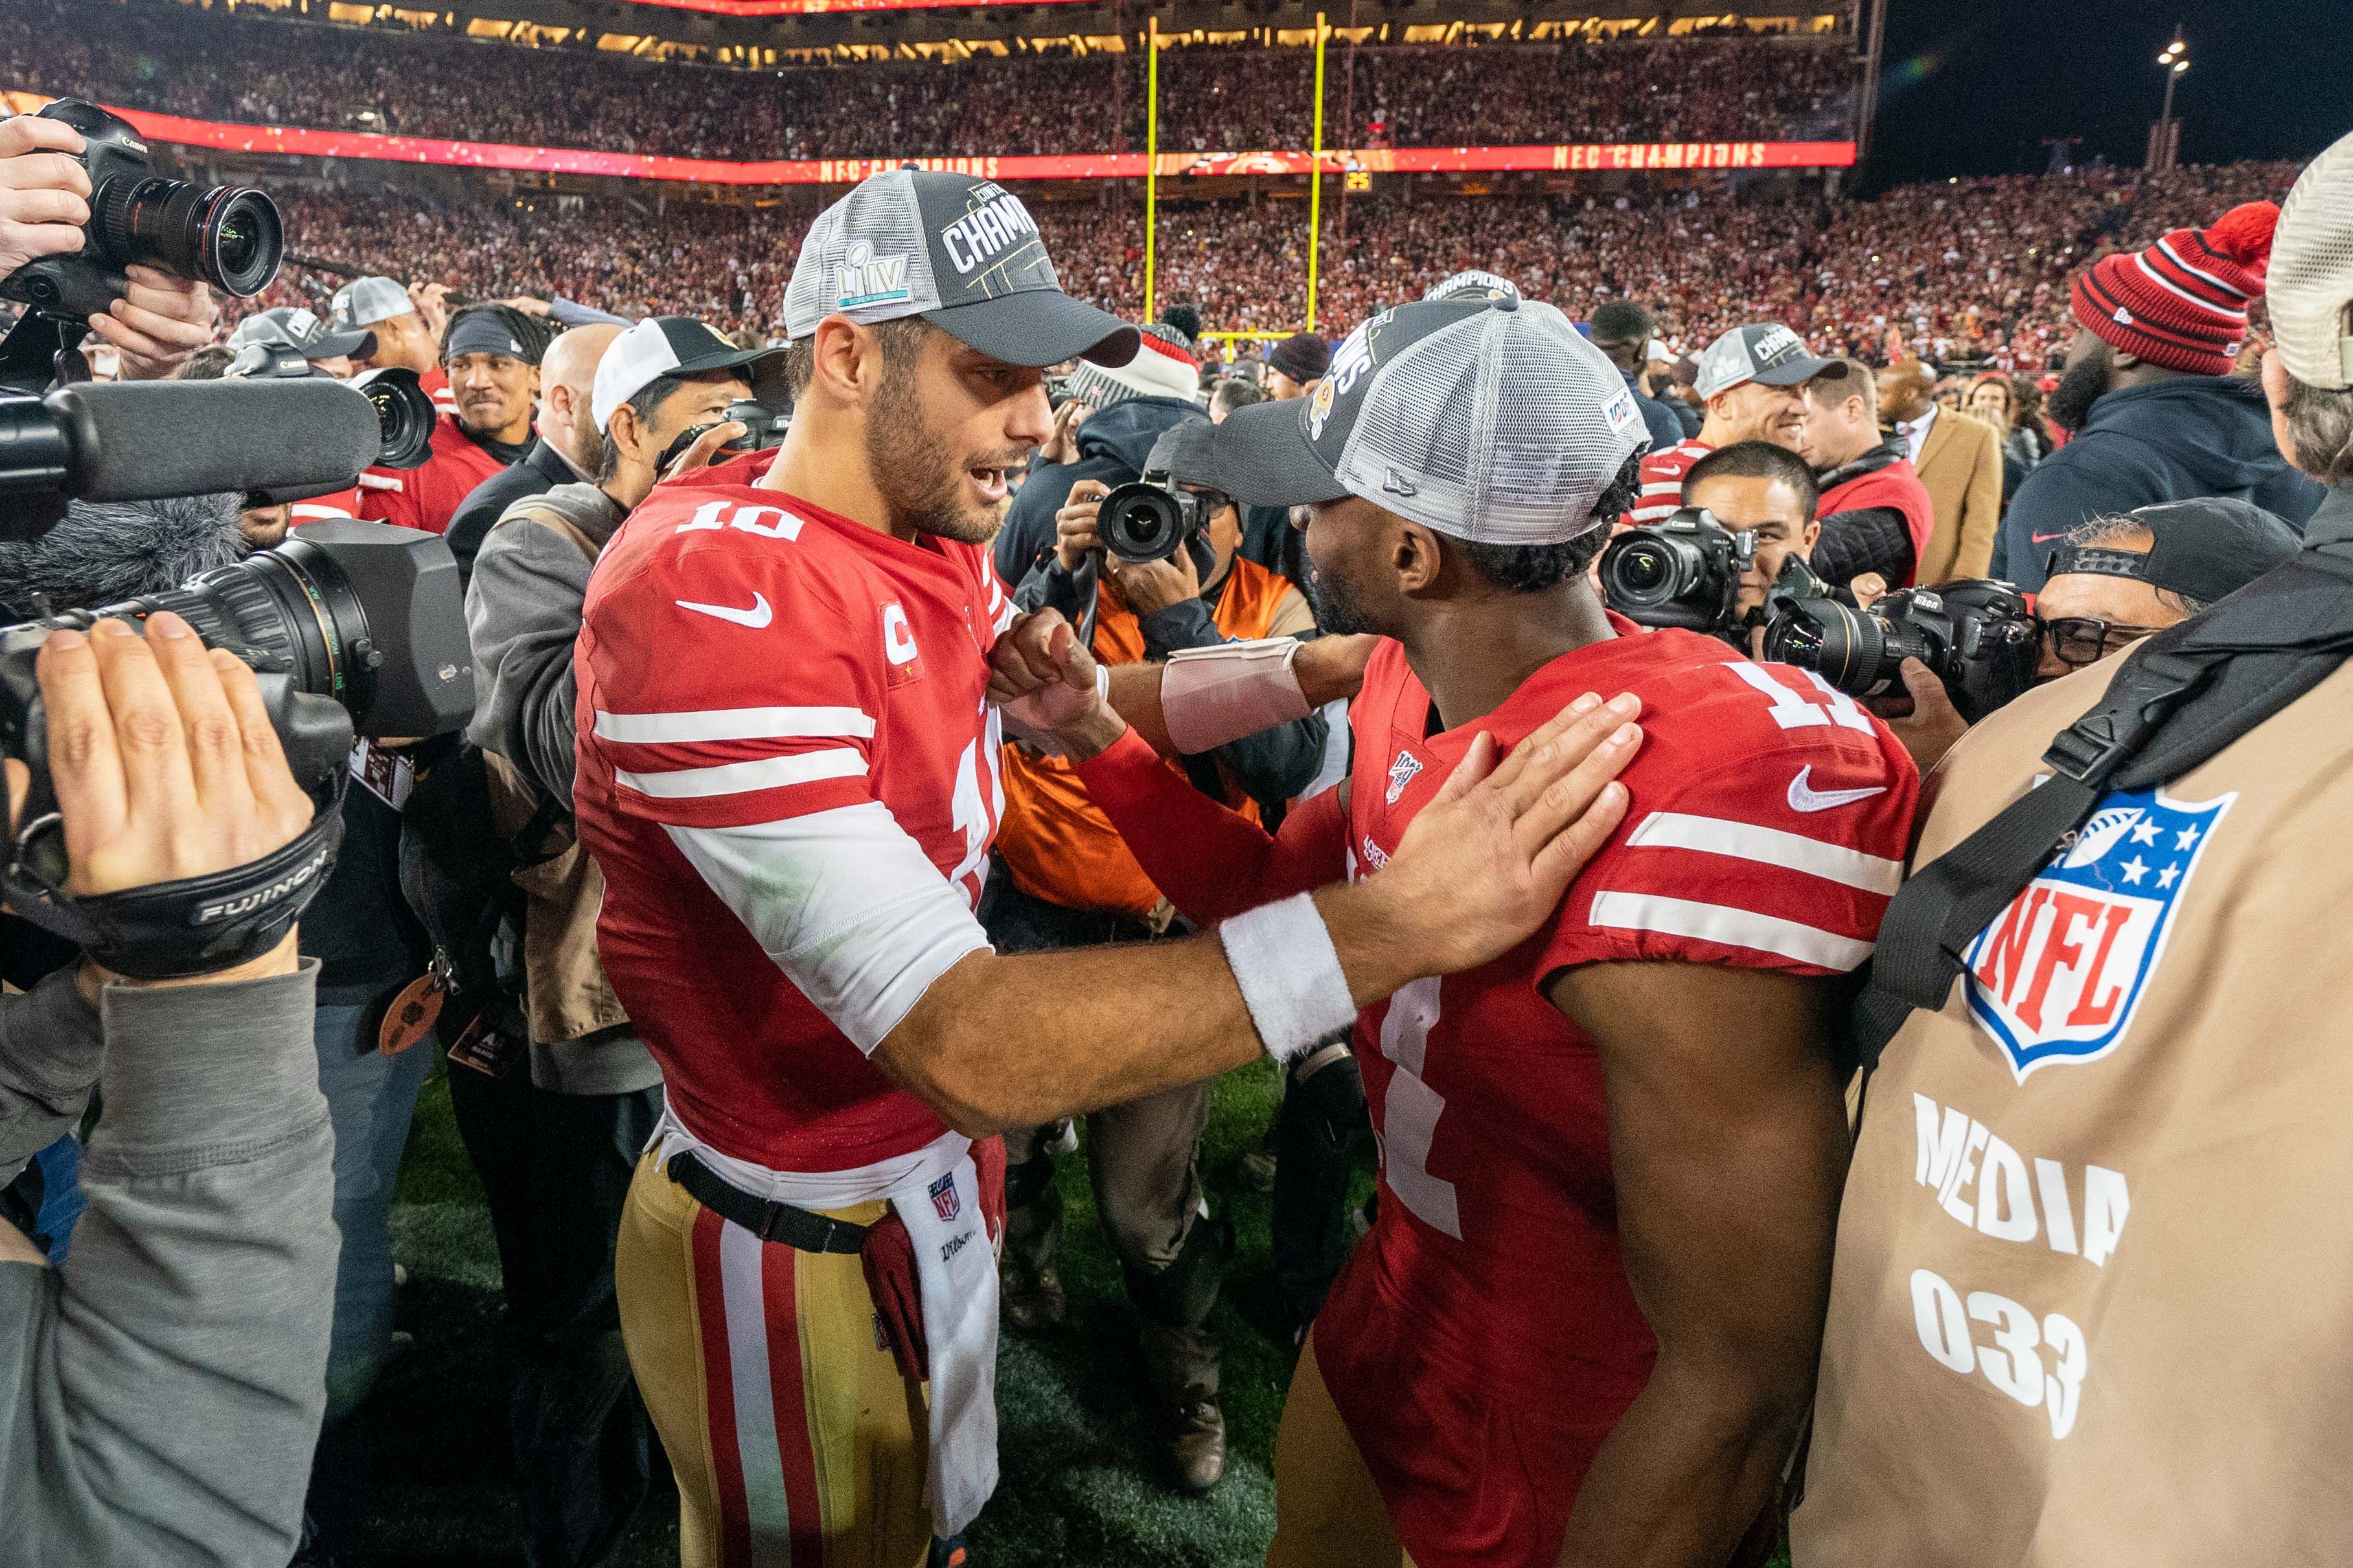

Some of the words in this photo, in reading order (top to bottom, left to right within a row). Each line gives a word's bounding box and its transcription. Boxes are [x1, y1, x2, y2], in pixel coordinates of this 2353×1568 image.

[122, 137, 148, 153] Canon
[1613, 143, 1765, 168] CHAMPIONS
[820, 160, 860, 183] NFC
[1348, 172, 1369, 189] 25
[676, 501, 804, 541] 10
[1671, 520, 1695, 528] Canon
[1913, 594, 1939, 609] Nikon
[884, 602, 918, 666] C
[200, 849, 327, 922] FUJINON
[1979, 885, 2133, 1035] NFL
[1912, 1092, 2131, 1268] MEDIA
[932, 1188, 958, 1220] NFL
[941, 1230, 976, 1262] Wilson
[1910, 1267, 2088, 1441] 033
